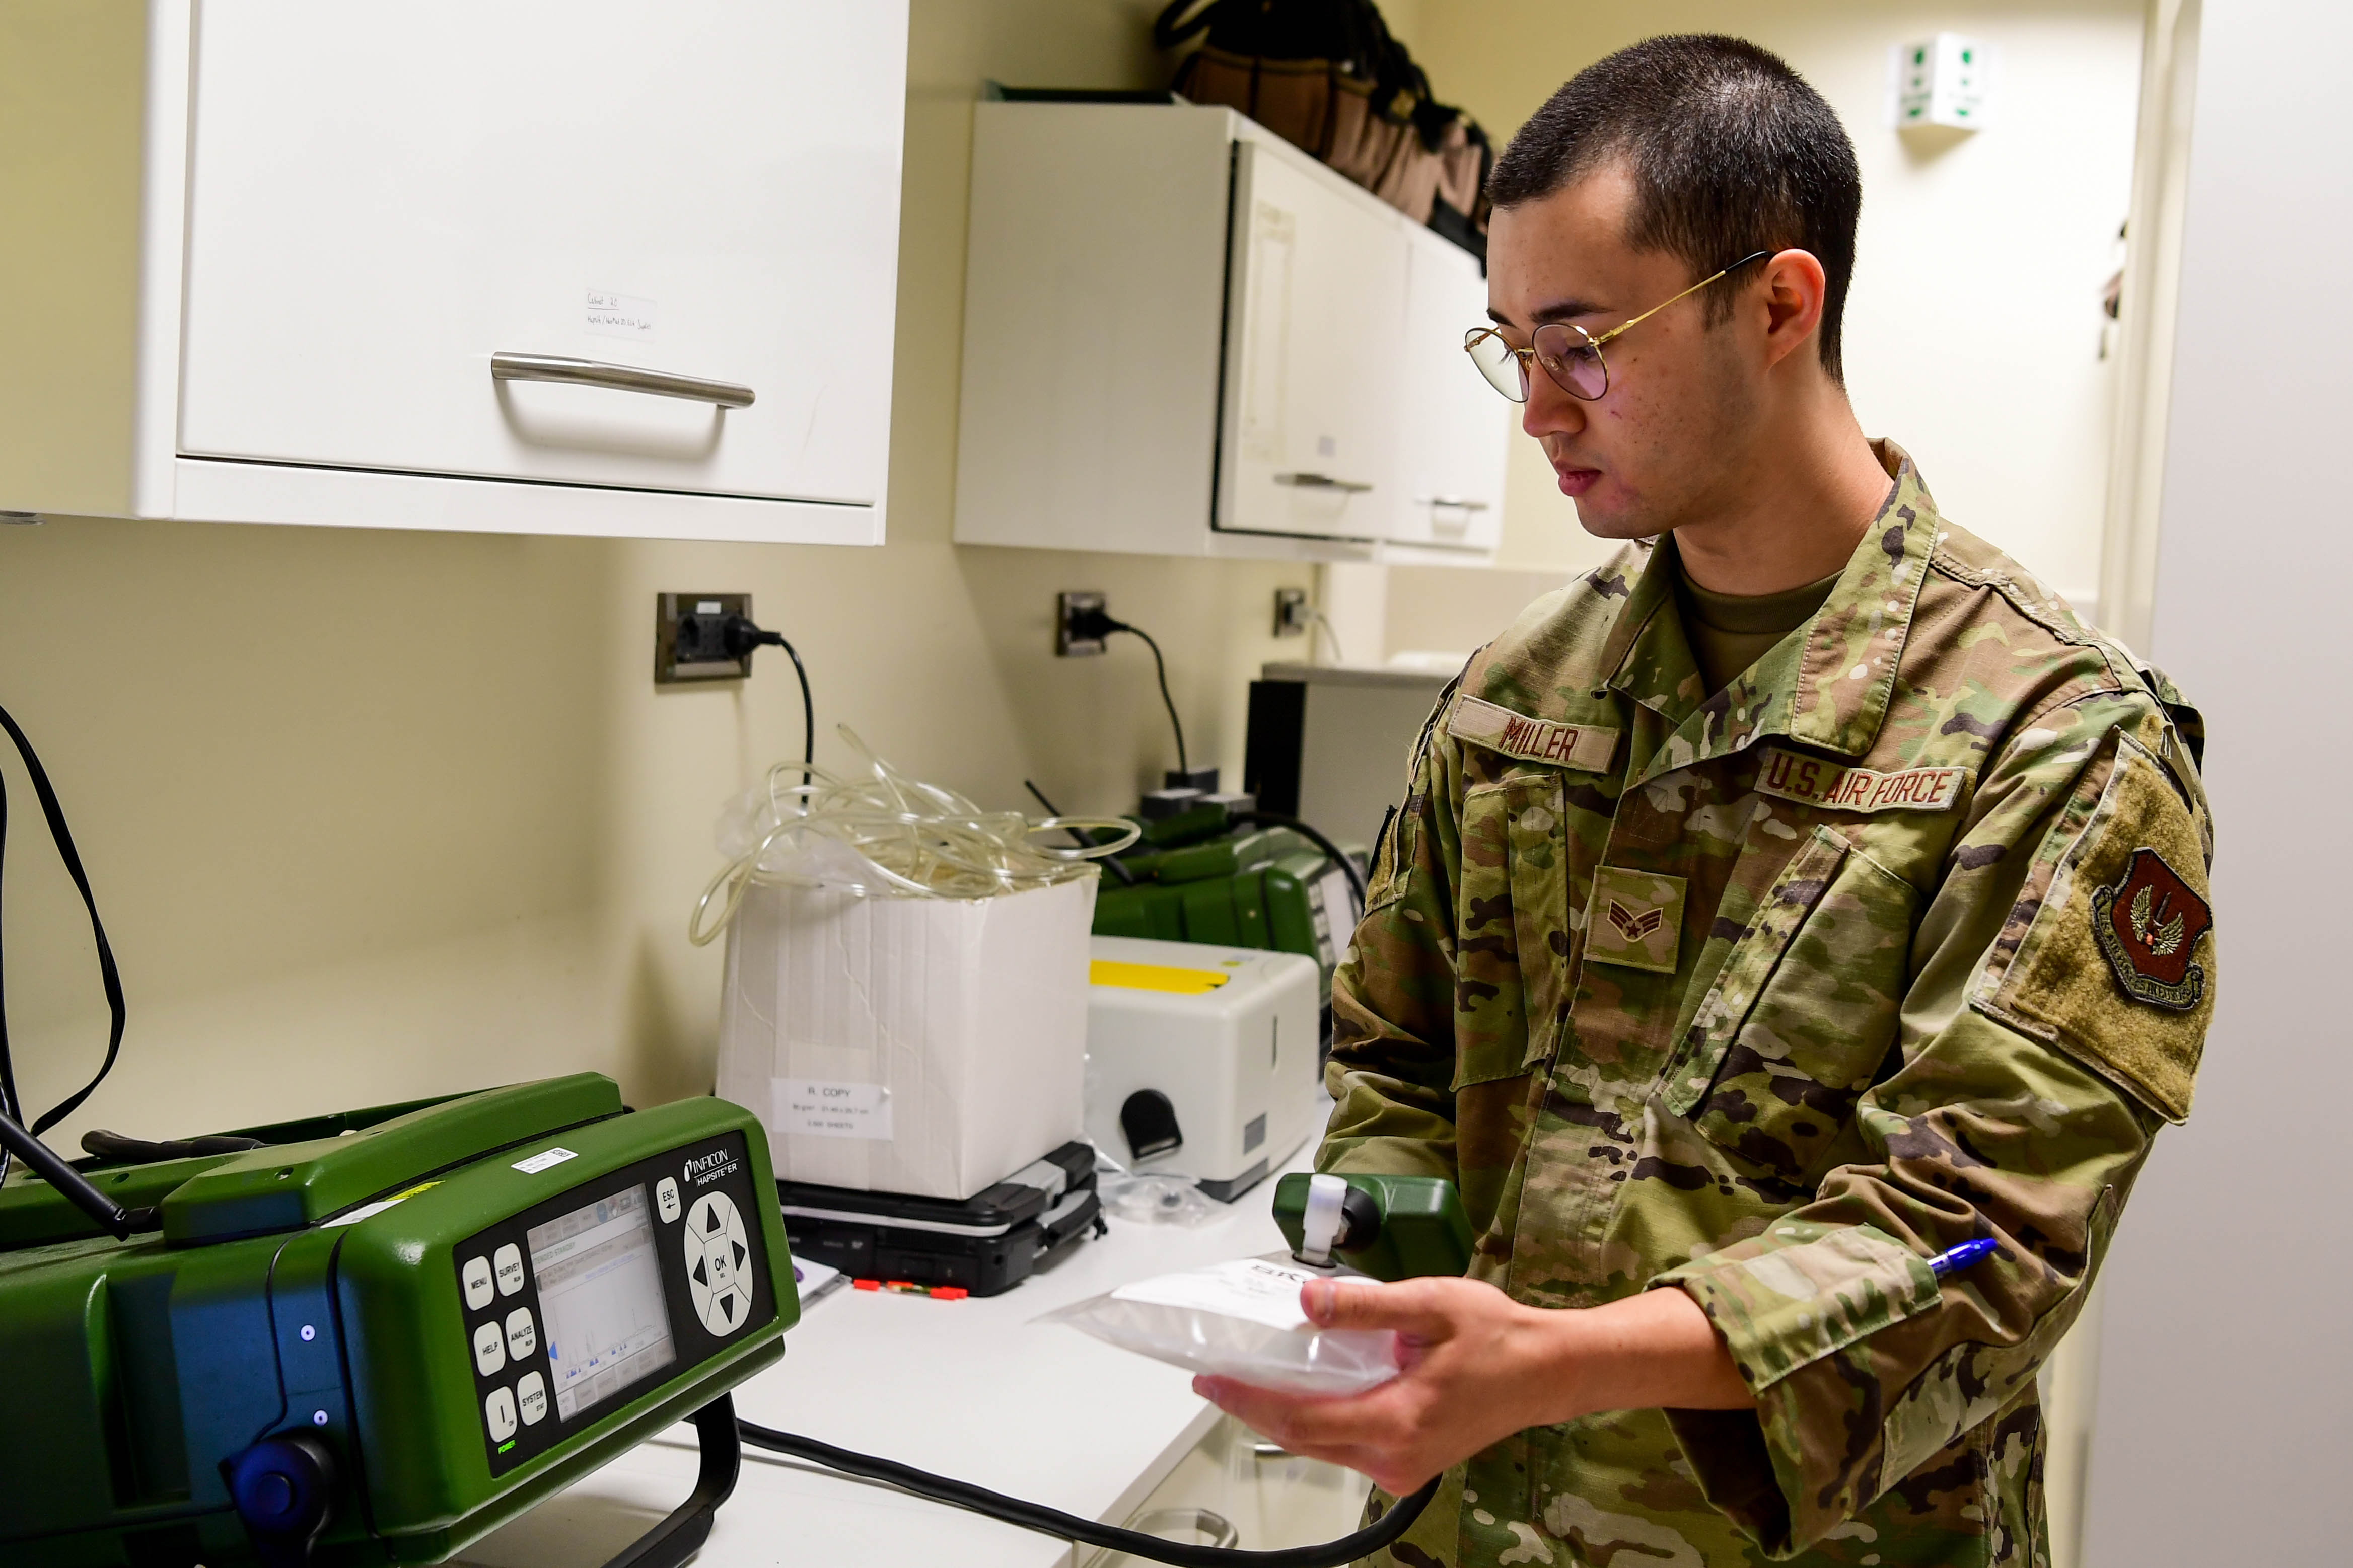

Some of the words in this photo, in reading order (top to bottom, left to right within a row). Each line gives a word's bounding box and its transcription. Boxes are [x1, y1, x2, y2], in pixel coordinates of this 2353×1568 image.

[1499, 717, 1579, 762] MILLER
[1767, 753, 1824, 802] U.S.
[1822, 770, 1873, 805] AIR
[1868, 770, 1953, 808] FORCE
[823, 1088, 851, 1097] COPY
[692, 1148, 728, 1174] INFICON
[727, 1163, 738, 1174] ER
[662, 1189, 675, 1202] ESC
[498, 1262, 520, 1278] SURVEY
[715, 1255, 727, 1271] OK
[471, 1276, 487, 1290] MENU
[511, 1325, 533, 1342] ANALYZE
[482, 1341, 498, 1356] HELP
[522, 1389, 543, 1407] SYSTEM
